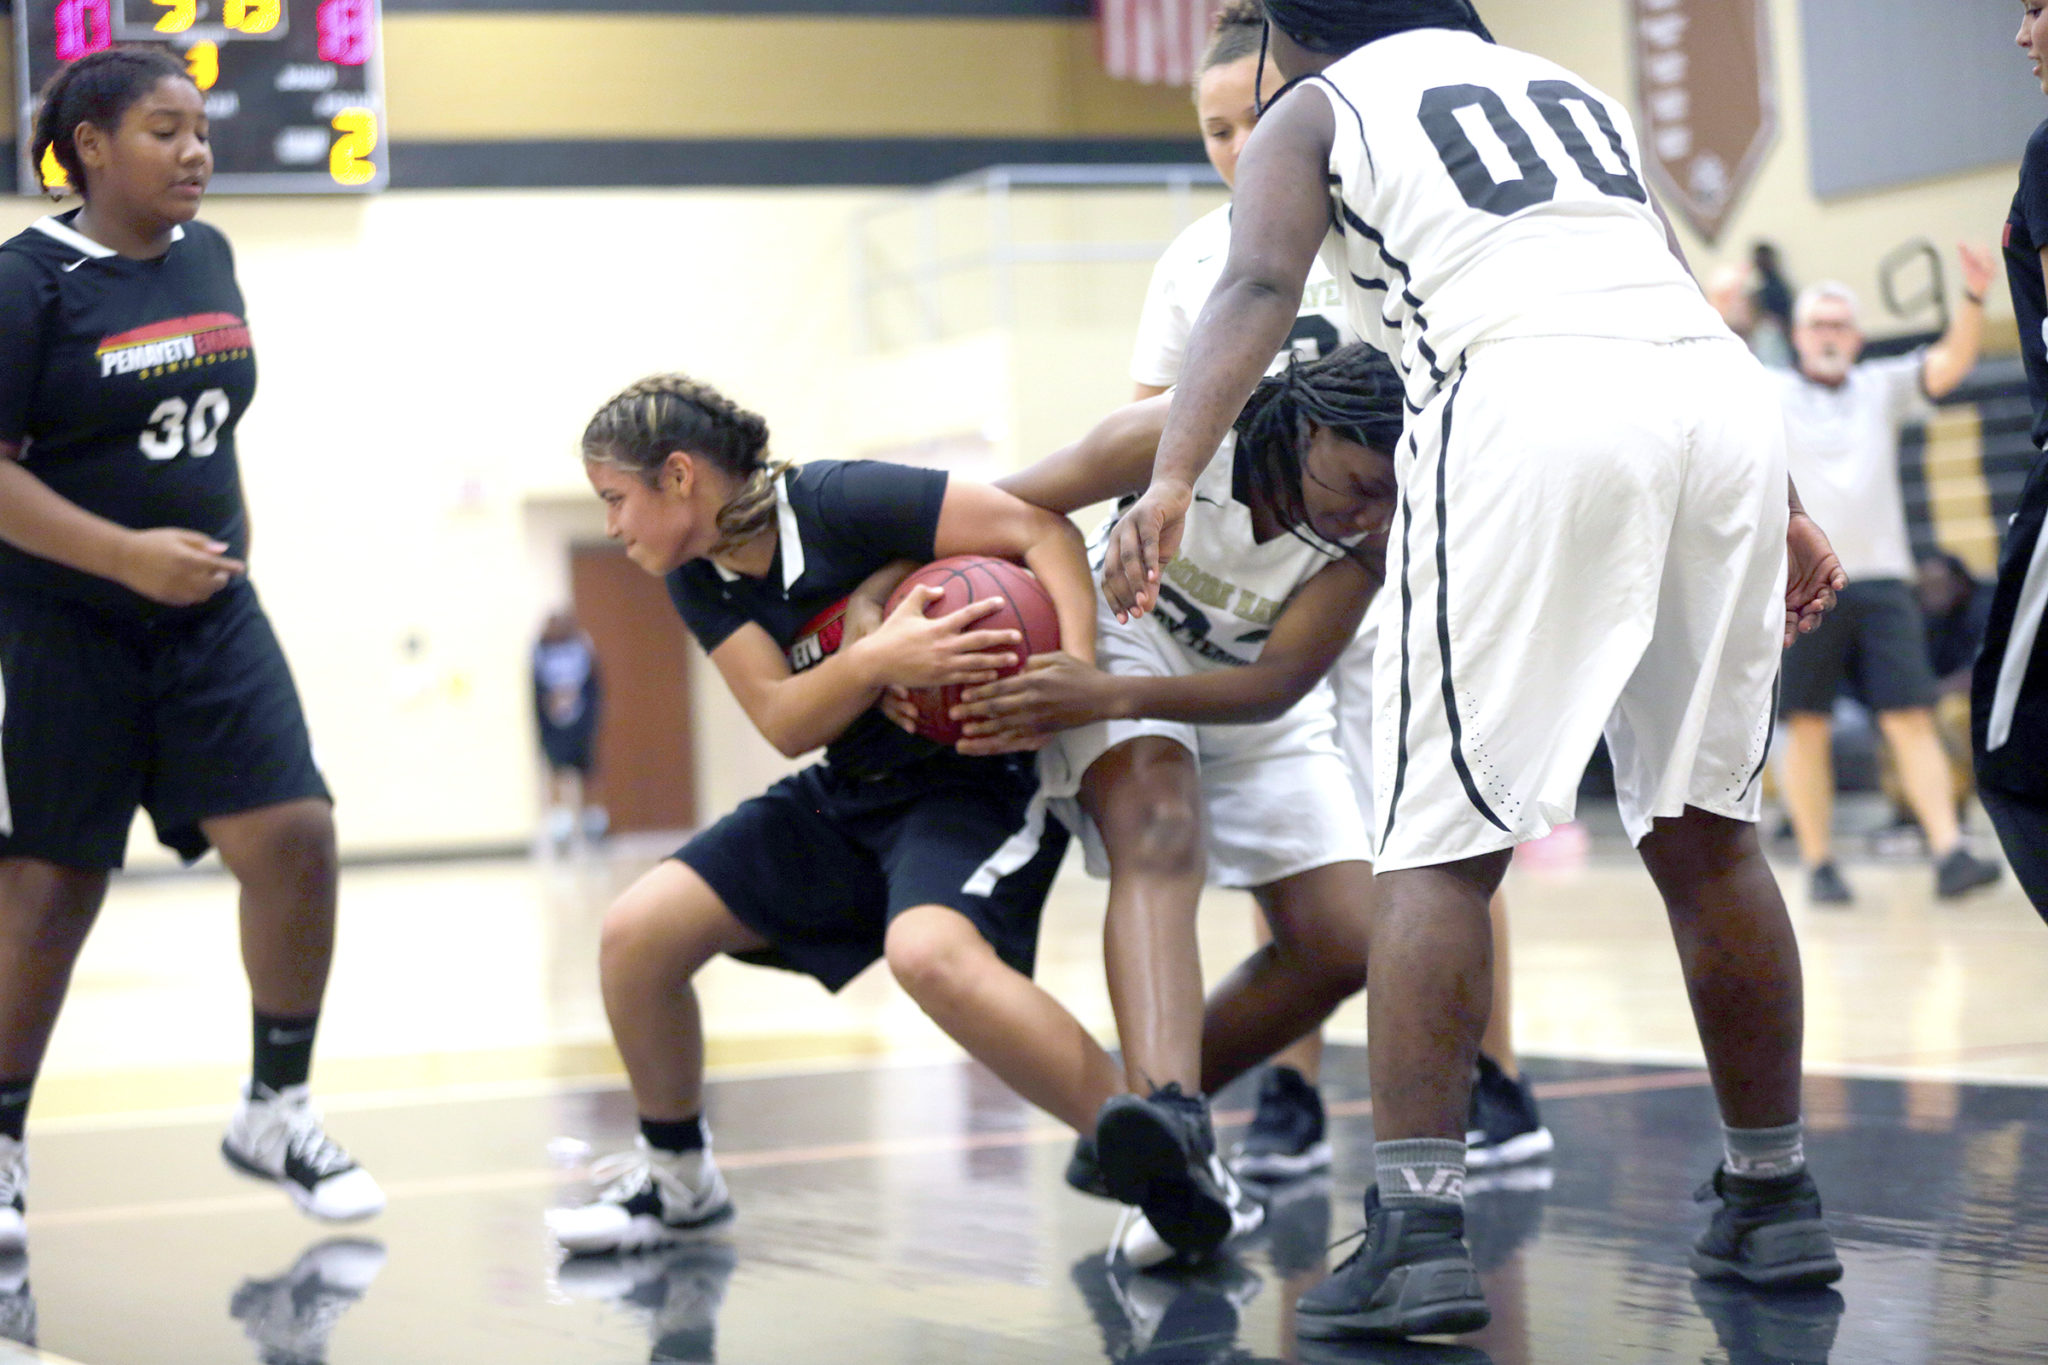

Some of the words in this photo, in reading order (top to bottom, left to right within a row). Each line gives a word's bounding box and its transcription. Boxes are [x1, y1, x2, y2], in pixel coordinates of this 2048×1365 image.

[330, 107, 378, 186] 2
[1417, 79, 1647, 217] 00
[139, 388, 230, 461] 30
